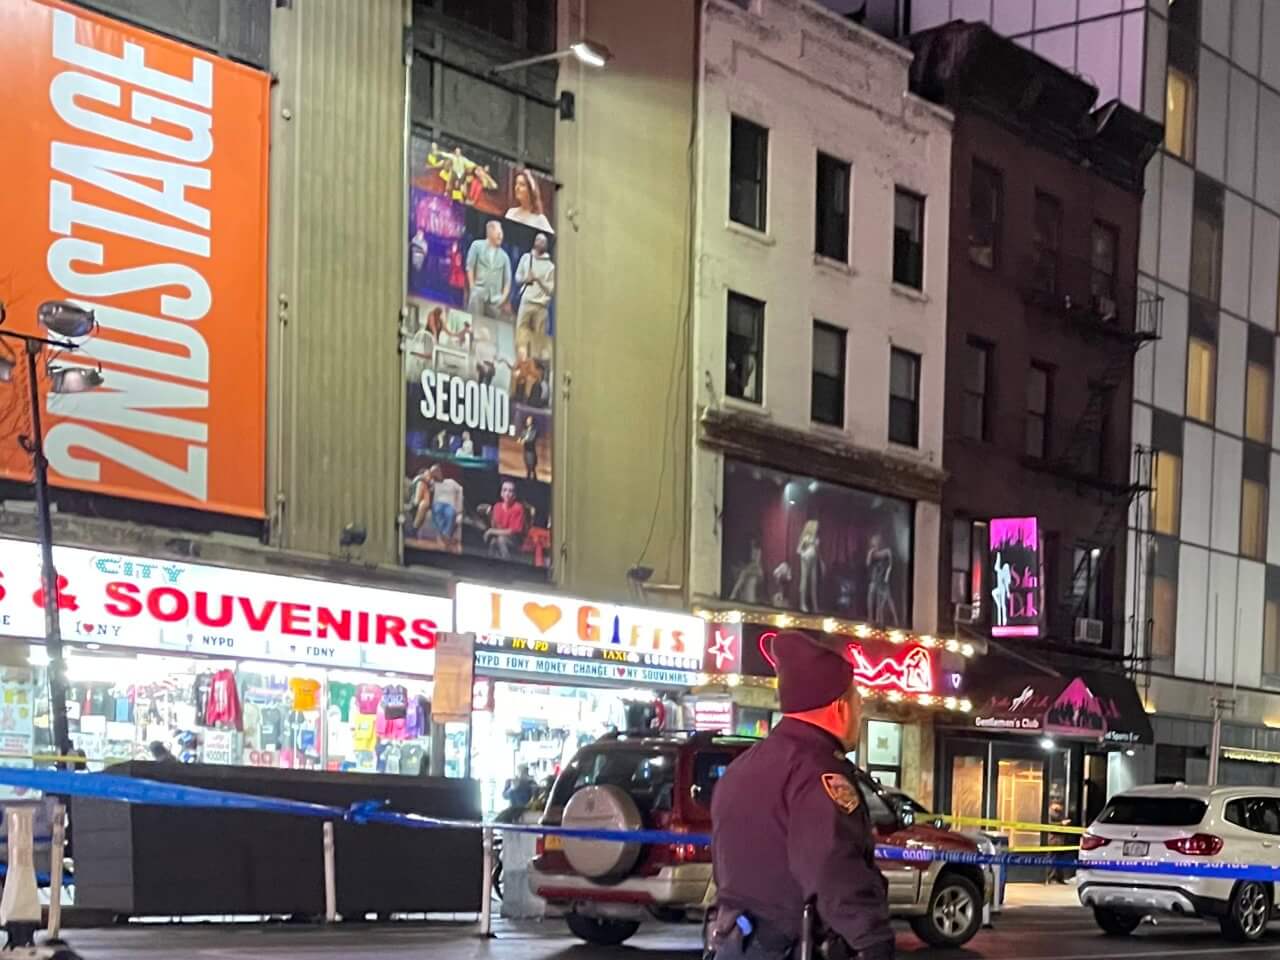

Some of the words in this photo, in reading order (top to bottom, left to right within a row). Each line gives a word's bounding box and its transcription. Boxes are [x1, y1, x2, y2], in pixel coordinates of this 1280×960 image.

[420, 368, 516, 436] SECOND.
[95, 557, 185, 582] CITY
[104, 581, 438, 650] SOUVENIRS
[202, 635, 235, 647] NYPD
[474, 653, 500, 666] NYPD
[536, 659, 567, 673] MONEY
[573, 663, 608, 677] CHANGE
[1021, 718, 1039, 728] Club
